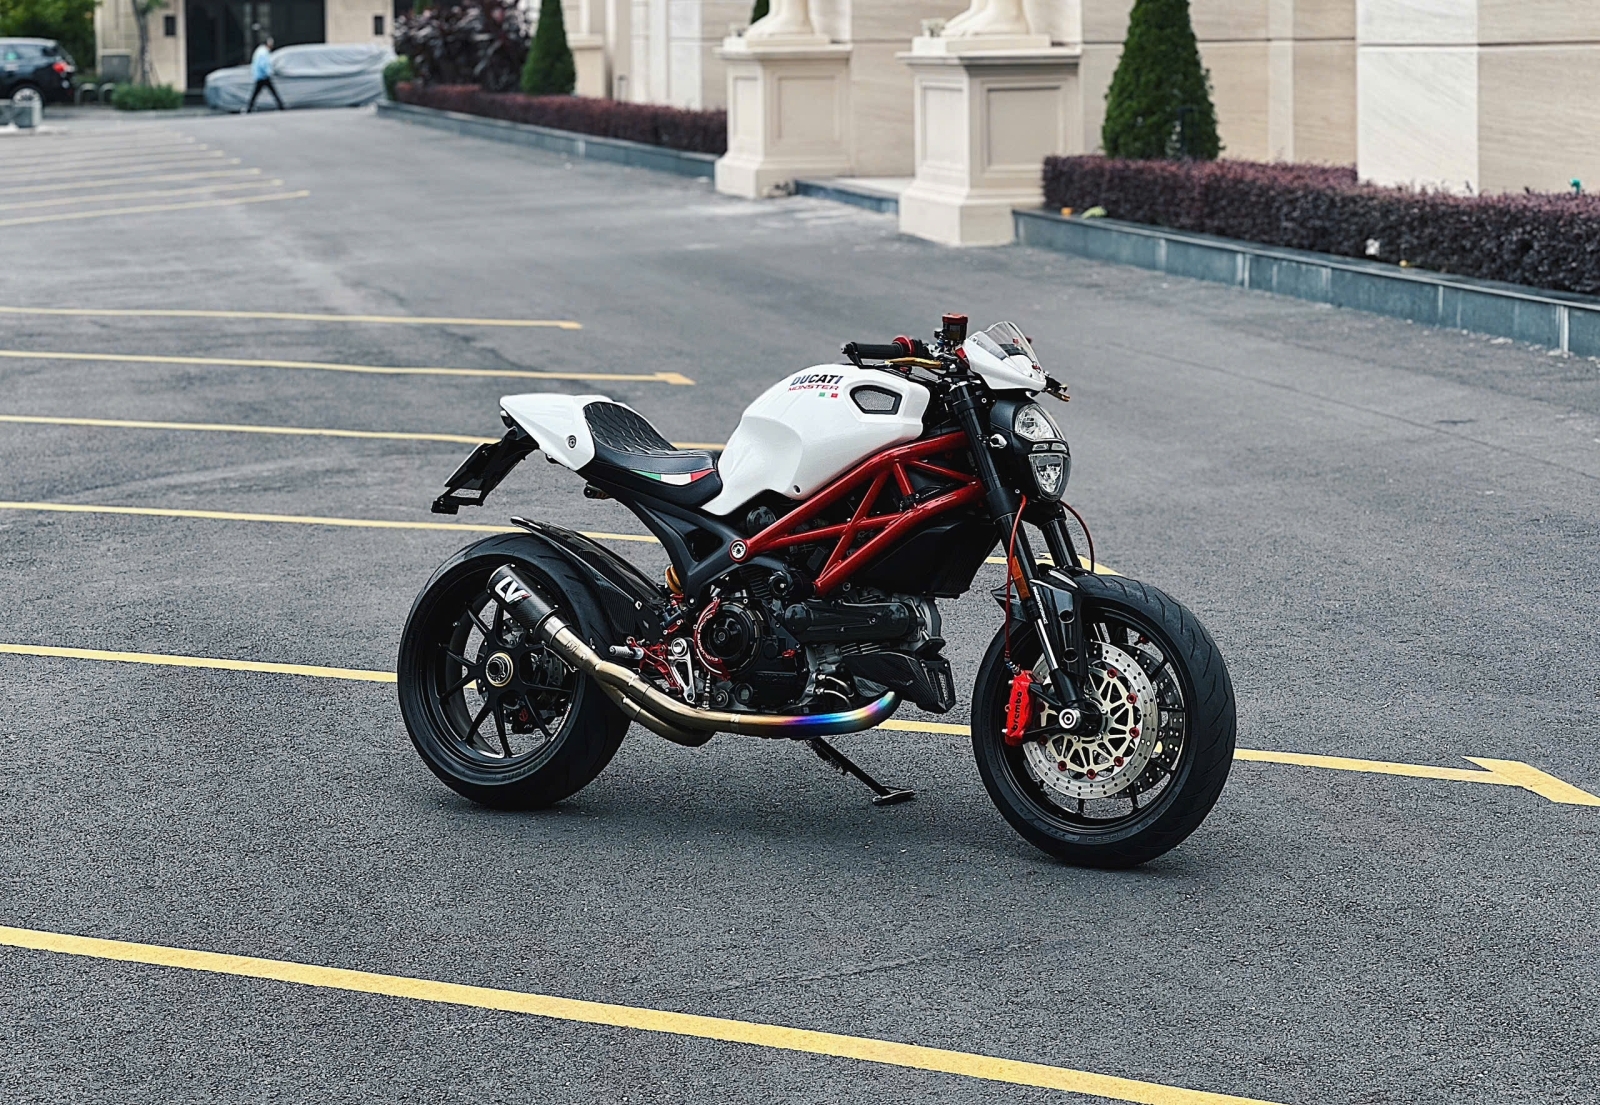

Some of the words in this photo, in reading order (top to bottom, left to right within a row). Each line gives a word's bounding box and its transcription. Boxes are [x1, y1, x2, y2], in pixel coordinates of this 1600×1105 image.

[790, 374, 844, 386] DUCATI
[788, 384, 839, 392] MONSTER
[1011, 691, 1022, 732] brembo
